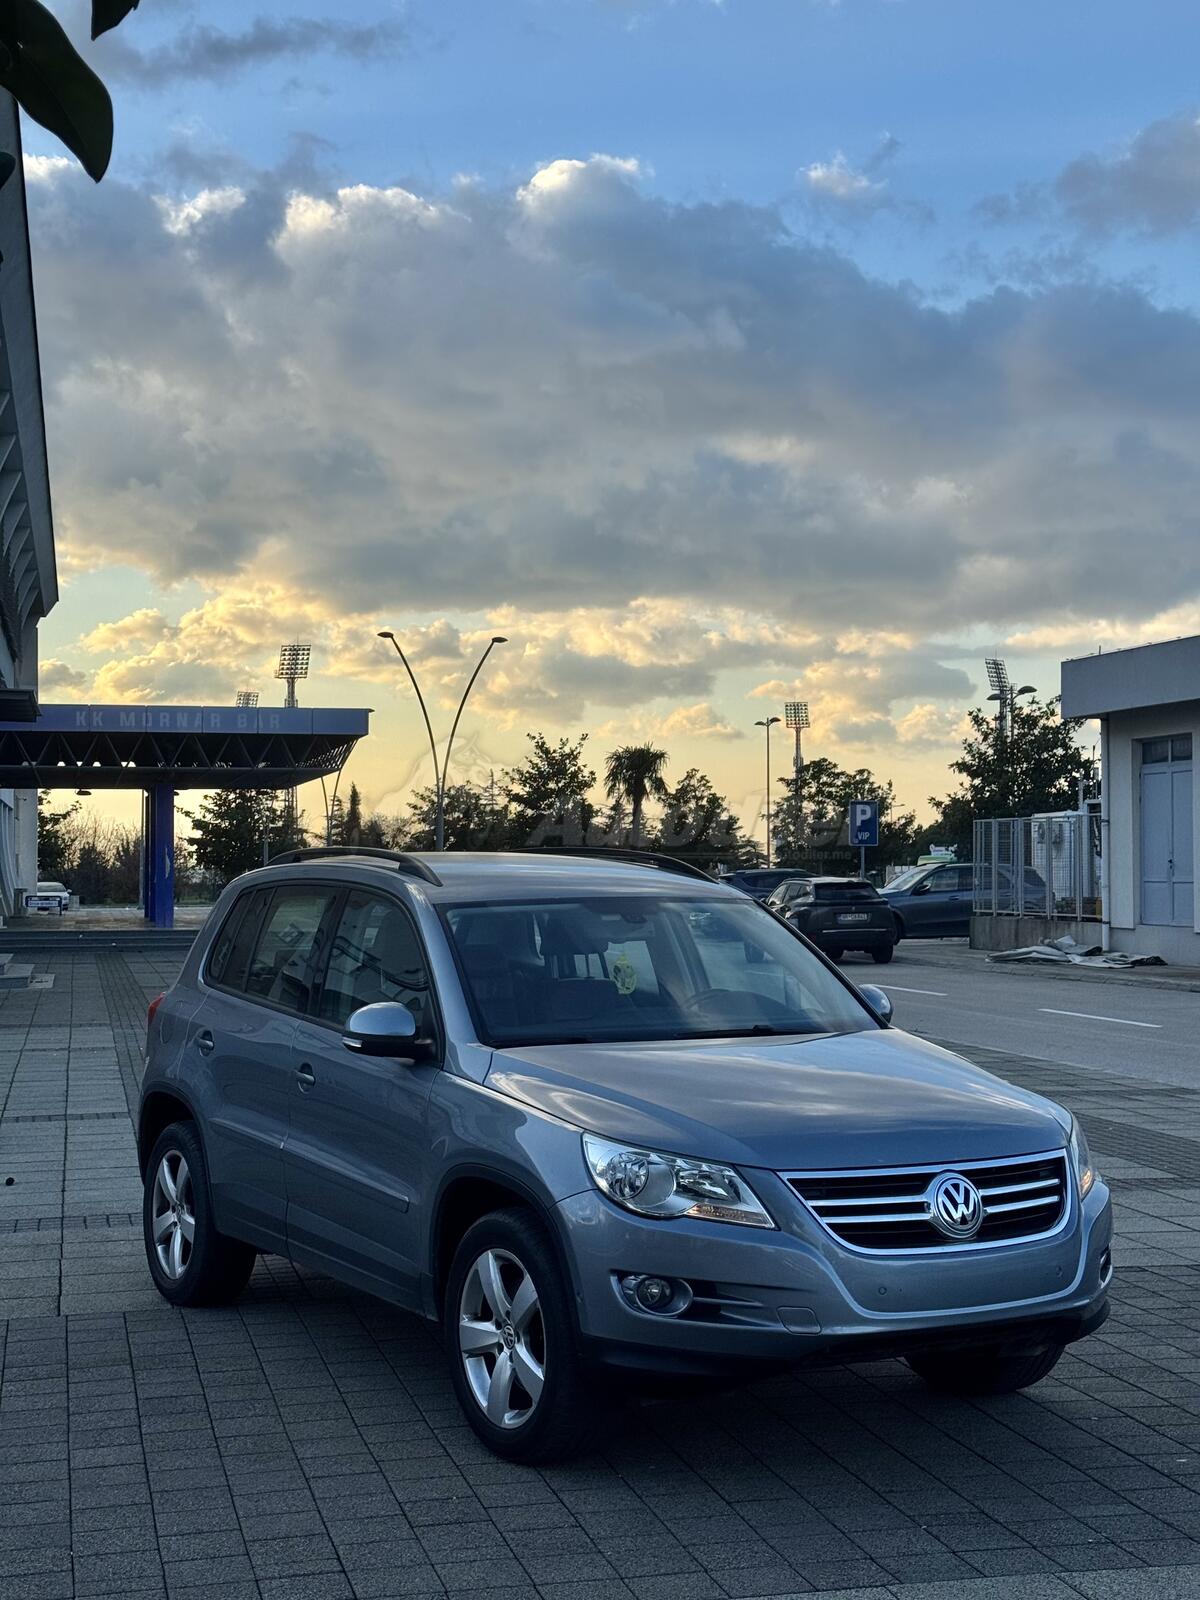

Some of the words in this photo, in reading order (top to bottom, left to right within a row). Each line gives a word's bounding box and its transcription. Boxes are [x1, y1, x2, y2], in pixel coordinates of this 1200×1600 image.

[76, 711, 103, 726] KK
[237, 713, 280, 729] BAR
[856, 804, 871, 827] P
[857, 831, 870, 841] VIP
